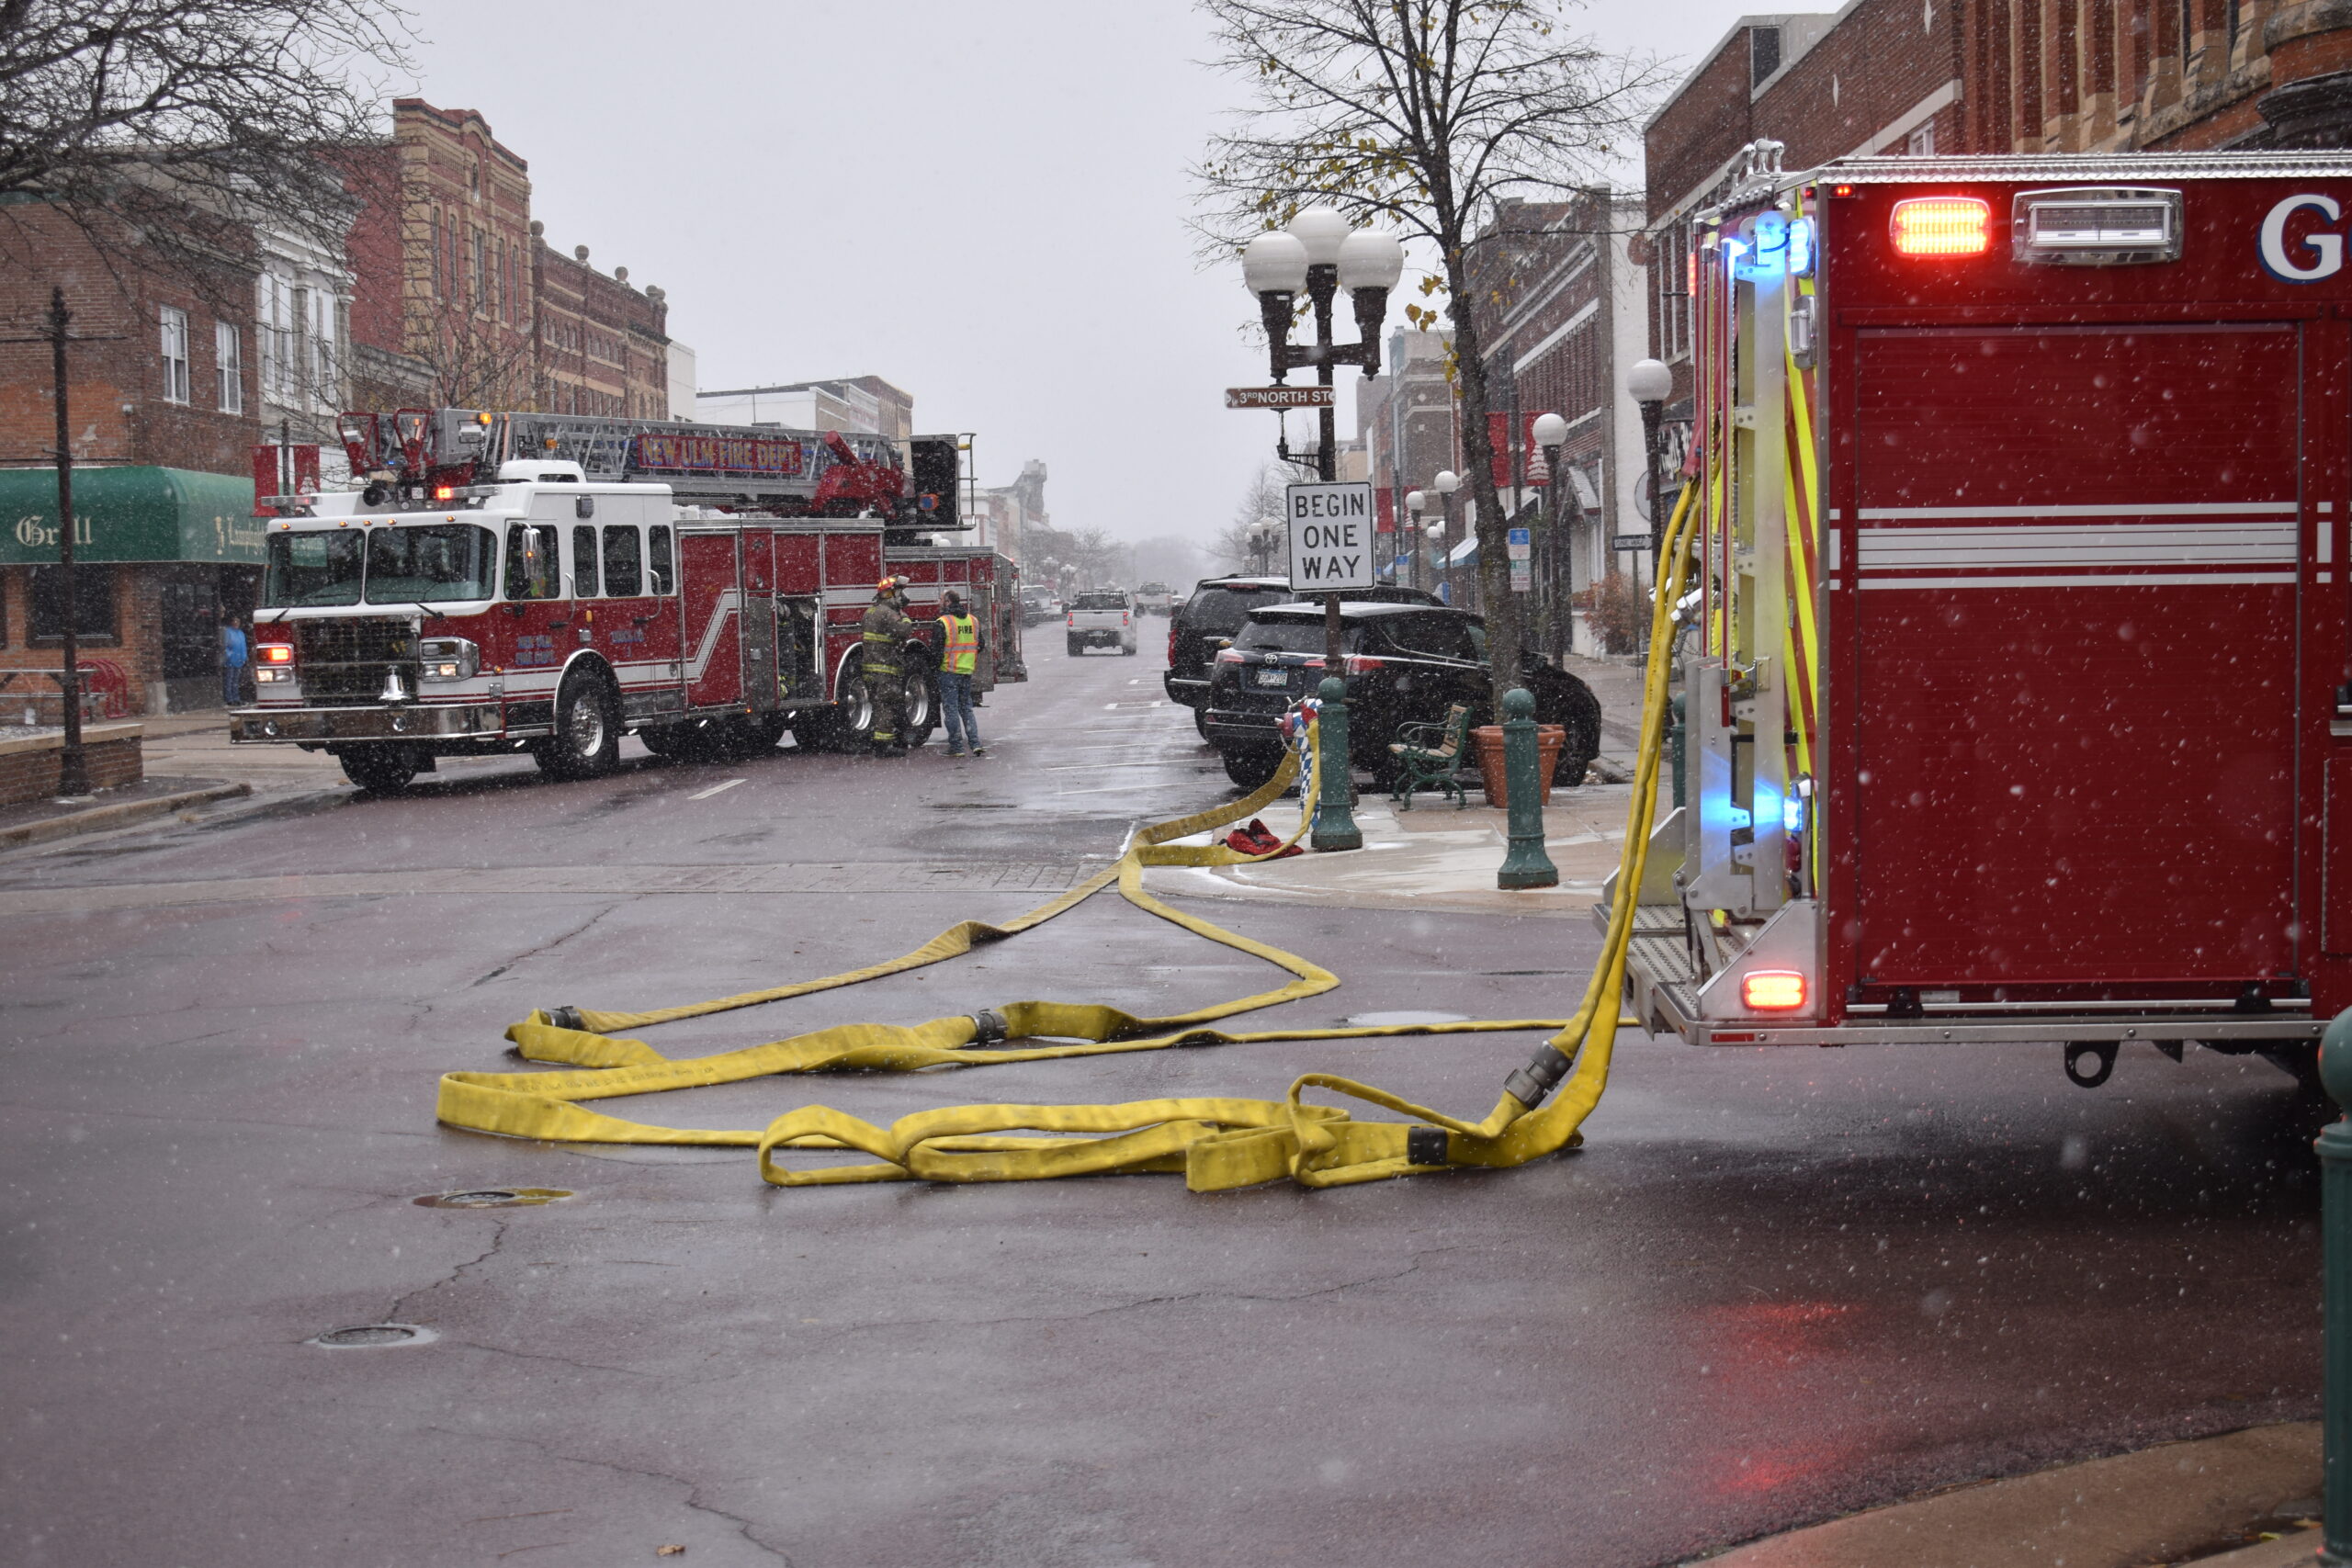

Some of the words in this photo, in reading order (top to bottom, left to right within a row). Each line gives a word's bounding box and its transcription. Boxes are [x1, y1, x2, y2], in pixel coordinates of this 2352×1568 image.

[1258, 390, 1307, 403] NORTH
[1312, 390, 1330, 402] ST
[642, 436, 677, 467] NEW
[681, 438, 715, 468] ULM
[718, 440, 753, 469] FIRE
[756, 442, 798, 471] DEPT.
[1295, 493, 1364, 518] BEGIN
[16, 514, 93, 547] Grll
[1304, 525, 1359, 549] ONE
[1302, 555, 1361, 581] WAY
[957, 625, 973, 635] FIRE
